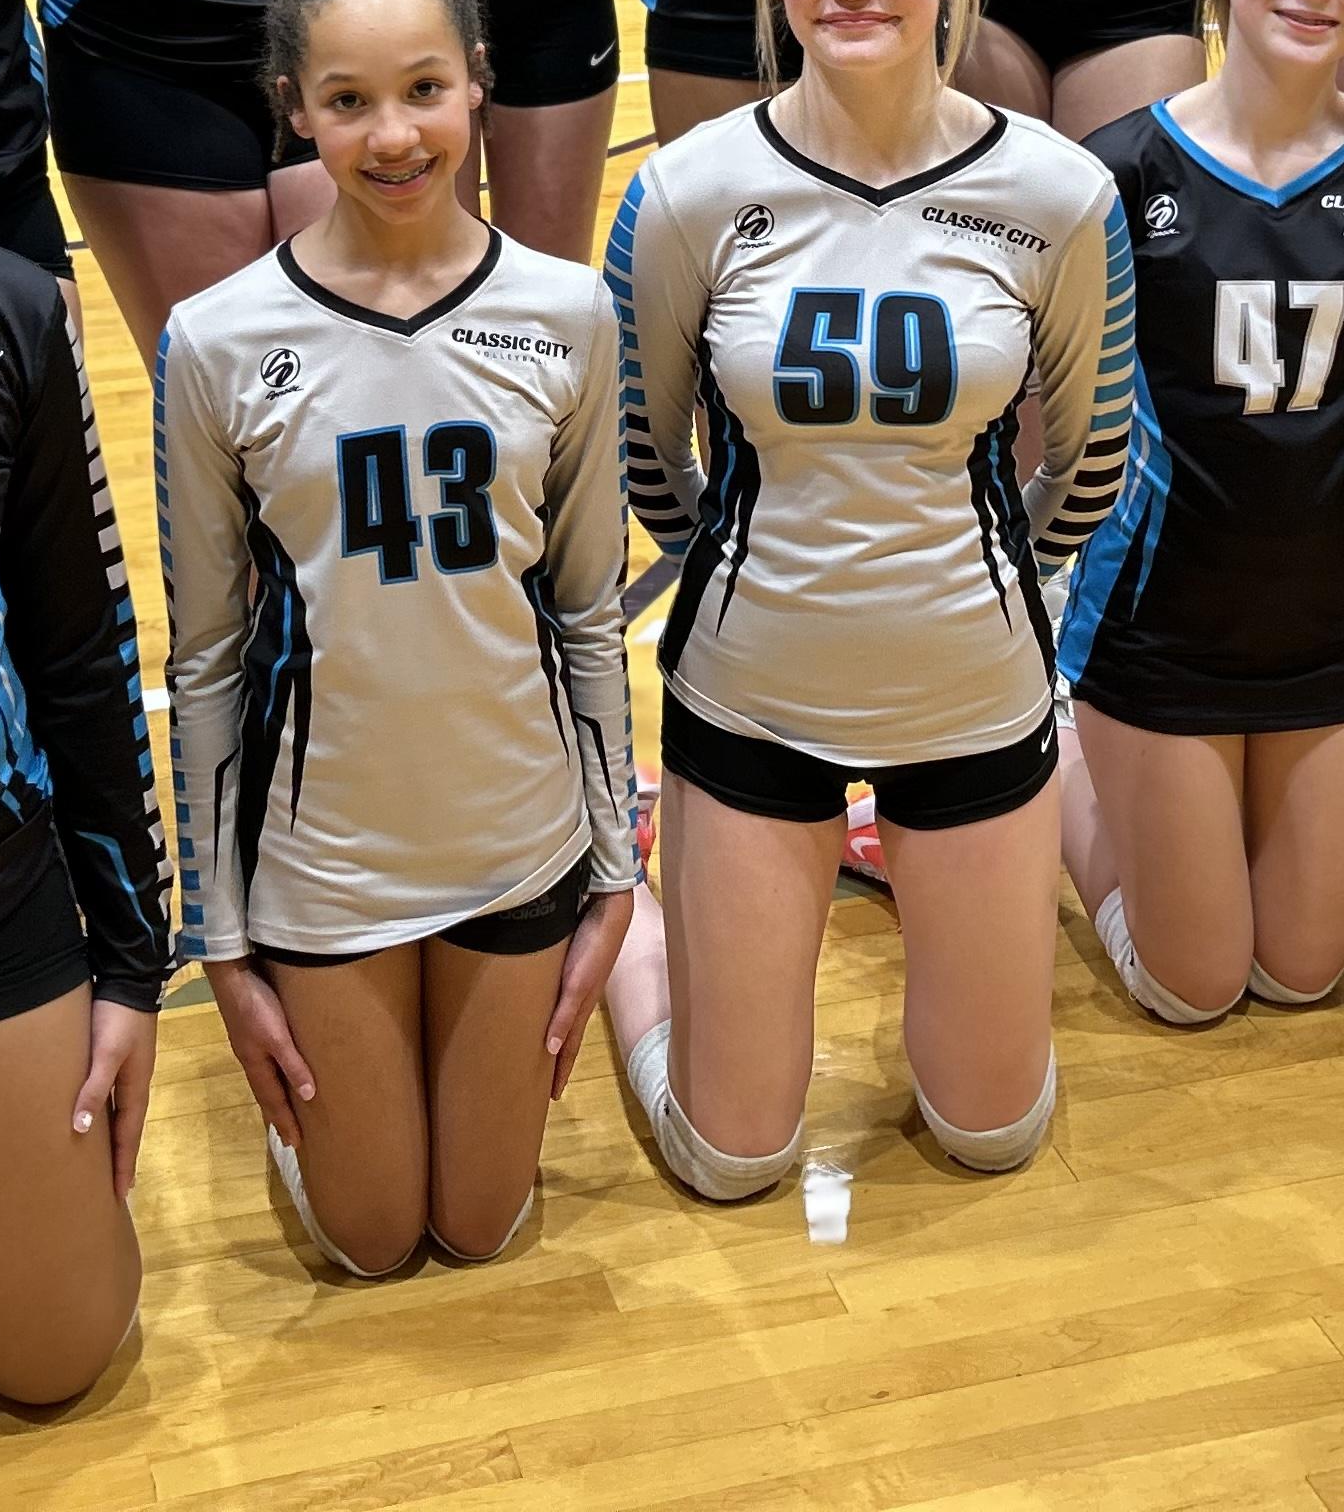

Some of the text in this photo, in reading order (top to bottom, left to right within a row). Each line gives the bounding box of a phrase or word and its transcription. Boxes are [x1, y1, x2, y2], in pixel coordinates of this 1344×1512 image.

[921, 206, 1052, 254] CLASSIC CITY
[943, 228, 1017, 255] VOLLEYBALL
[452, 328, 574, 360] CLASSIC CITY
[476, 349, 548, 367] VOLLEYBALL
[773, 286, 958, 427] 59
[336, 420, 499, 585] 43
